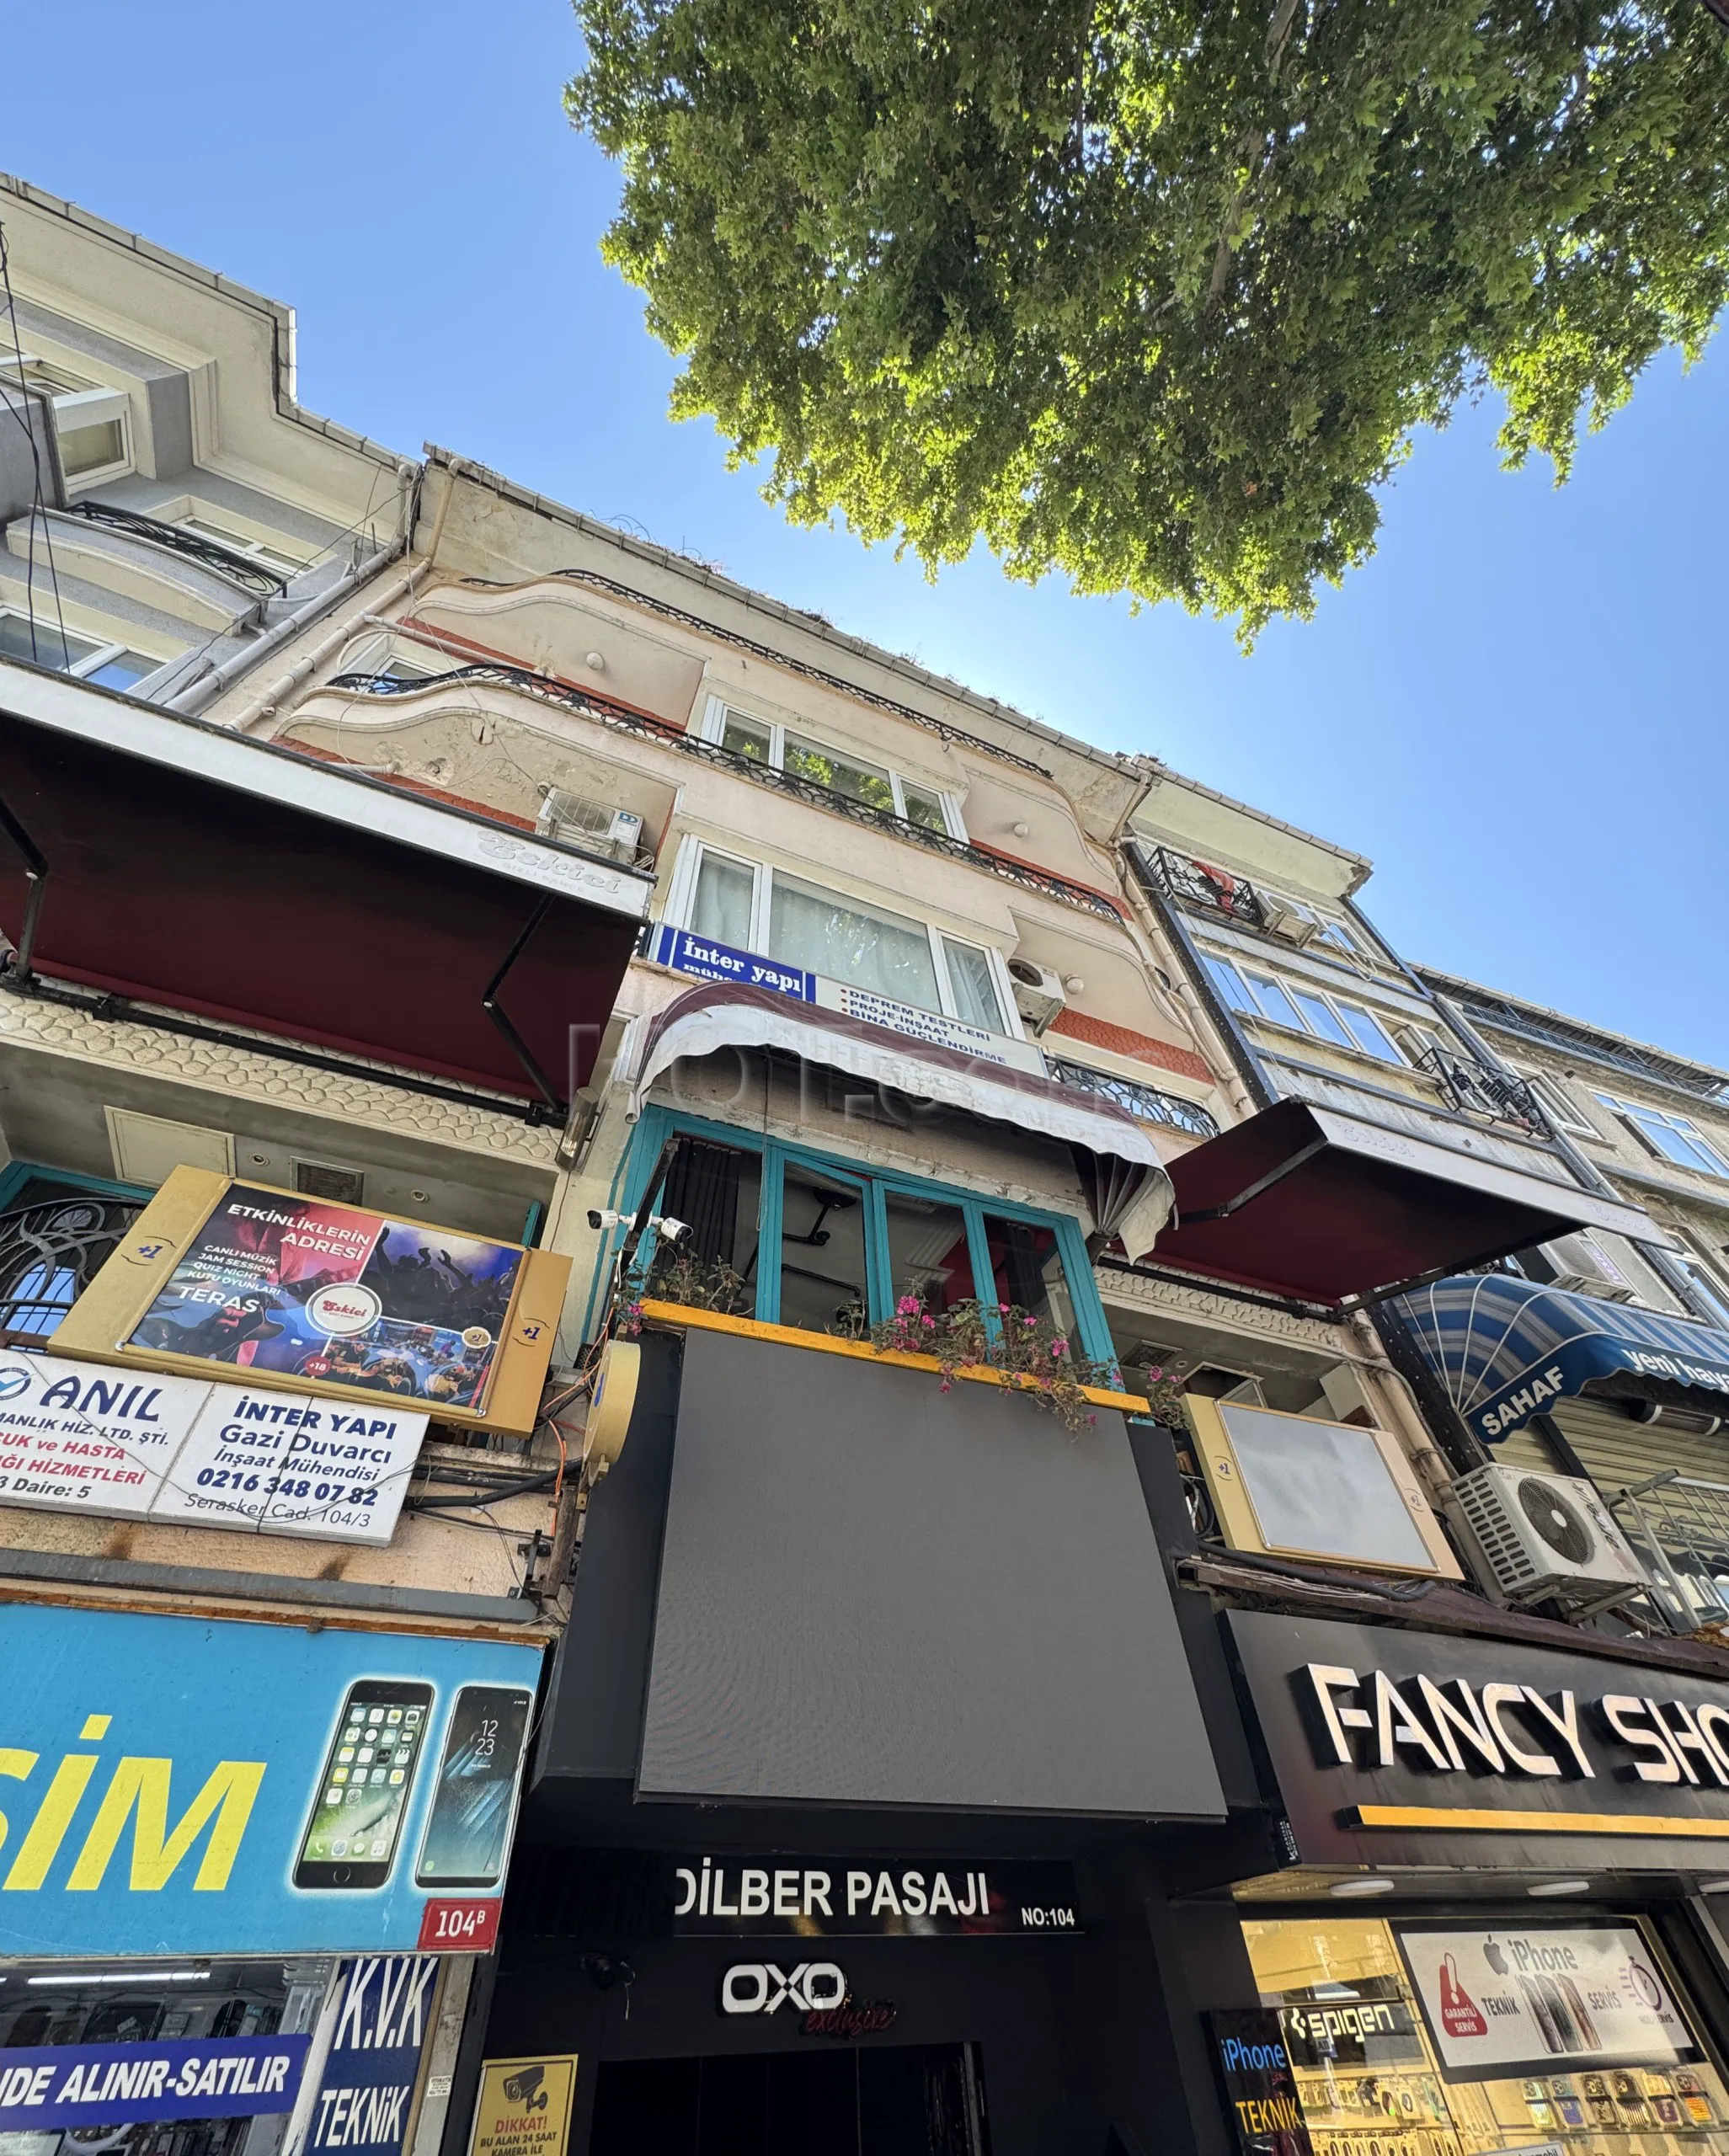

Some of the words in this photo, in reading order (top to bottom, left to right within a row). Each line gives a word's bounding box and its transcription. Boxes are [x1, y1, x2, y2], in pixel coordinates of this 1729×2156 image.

[683, 936, 745, 973] İnter
[750, 964, 802, 993] yapı
[849, 990, 916, 1017] DEPREM
[918, 1010, 990, 1043] TESTLERİ
[850, 1000, 950, 1038] PROJE-İNŞAAT
[850, 1007, 888, 1027] BİNA
[895, 1021, 1007, 1065] GÜÇLENDİRME
[227, 1203, 371, 1246] ETKİNLİKLERİN
[137, 1245, 163, 1259] +1
[204, 1245, 240, 1257] CANLI
[241, 1251, 280, 1267] MÜZİK
[280, 1231, 366, 1262] ADRESİ
[193, 1262, 223, 1273] QUIZ
[198, 1252, 225, 1263] JAM
[226, 1257, 276, 1275] SESSION
[179, 1285, 260, 1313] TERAS
[187, 1270, 221, 1283] KUTU
[222, 1276, 282, 1296] OYUNLARI
[522, 1326, 541, 1341] +1
[309, 1362, 326, 1372] +18
[1621, 1348, 1681, 1376] yeni
[40, 1374, 163, 1422] ANIL
[1481, 1365, 1564, 1437] SAHAF
[61, 1417, 93, 1435] HİZ.
[99, 1427, 133, 1441] LTD.
[139, 1431, 168, 1445] ŞTİ.
[233, 1395, 322, 1429] İNTER
[330, 1413, 398, 1440] YAPI
[37, 1440, 58, 1451] ve
[62, 1440, 126, 1460] HASTA
[220, 1423, 285, 1449] Gazi
[289, 1433, 392, 1465] Duvarcı
[0, 1453, 25, 1470] ĞI
[27, 1457, 147, 1486] HİZMETLERİ
[213, 1444, 275, 1469] İnşaat
[278, 1456, 381, 1482] Mühendisi
[12, 1476, 73, 1497] Daire:
[76, 1485, 92, 1499] 5
[196, 1467, 259, 1492] 0216
[263, 1476, 312, 1499] 348
[313, 1482, 346, 1502] 07
[348, 1486, 379, 1507] 82
[184, 1492, 266, 1516] Serasker
[271, 1502, 312, 1522] Cad.
[320, 1509, 371, 1529] 104/3
[481, 1719, 499, 1737] 12
[1308, 1662, 1597, 1780] FANCY
[475, 1738, 495, 1756] 23
[675, 1856, 834, 1916] DİLBER
[846, 1870, 990, 1916] PASAJI
[1021, 1907, 1075, 1927] NO:104
[1507, 1938, 1578, 1972] iPhone
[334, 1956, 439, 2050] K.V.K
[722, 1961, 847, 2014] OXO
[1481, 1989, 1521, 2018] TEKNİK
[1587, 1985, 1623, 2011] SERVİS
[1307, 2004, 1395, 2044] spigen
[1454, 2020, 1478, 2034] SERVİS
[1221, 2036, 1288, 2073] iPhone
[55, 2056, 291, 2104] ALINIR-SATILIR
[313, 2084, 410, 2148] TEKNİK
[494, 2115, 547, 2134] DİKKAT!
[1235, 2092, 1304, 2135] TEKNİK
[480, 2137, 494, 2148] BU
[495, 2134, 520, 2147] ALAN
[522, 2133, 534, 2144] 24
[535, 2131, 558, 2143] SAAT
[491, 2146, 528, 2156] KAMERA
[530, 2143, 544, 2155] İLE
